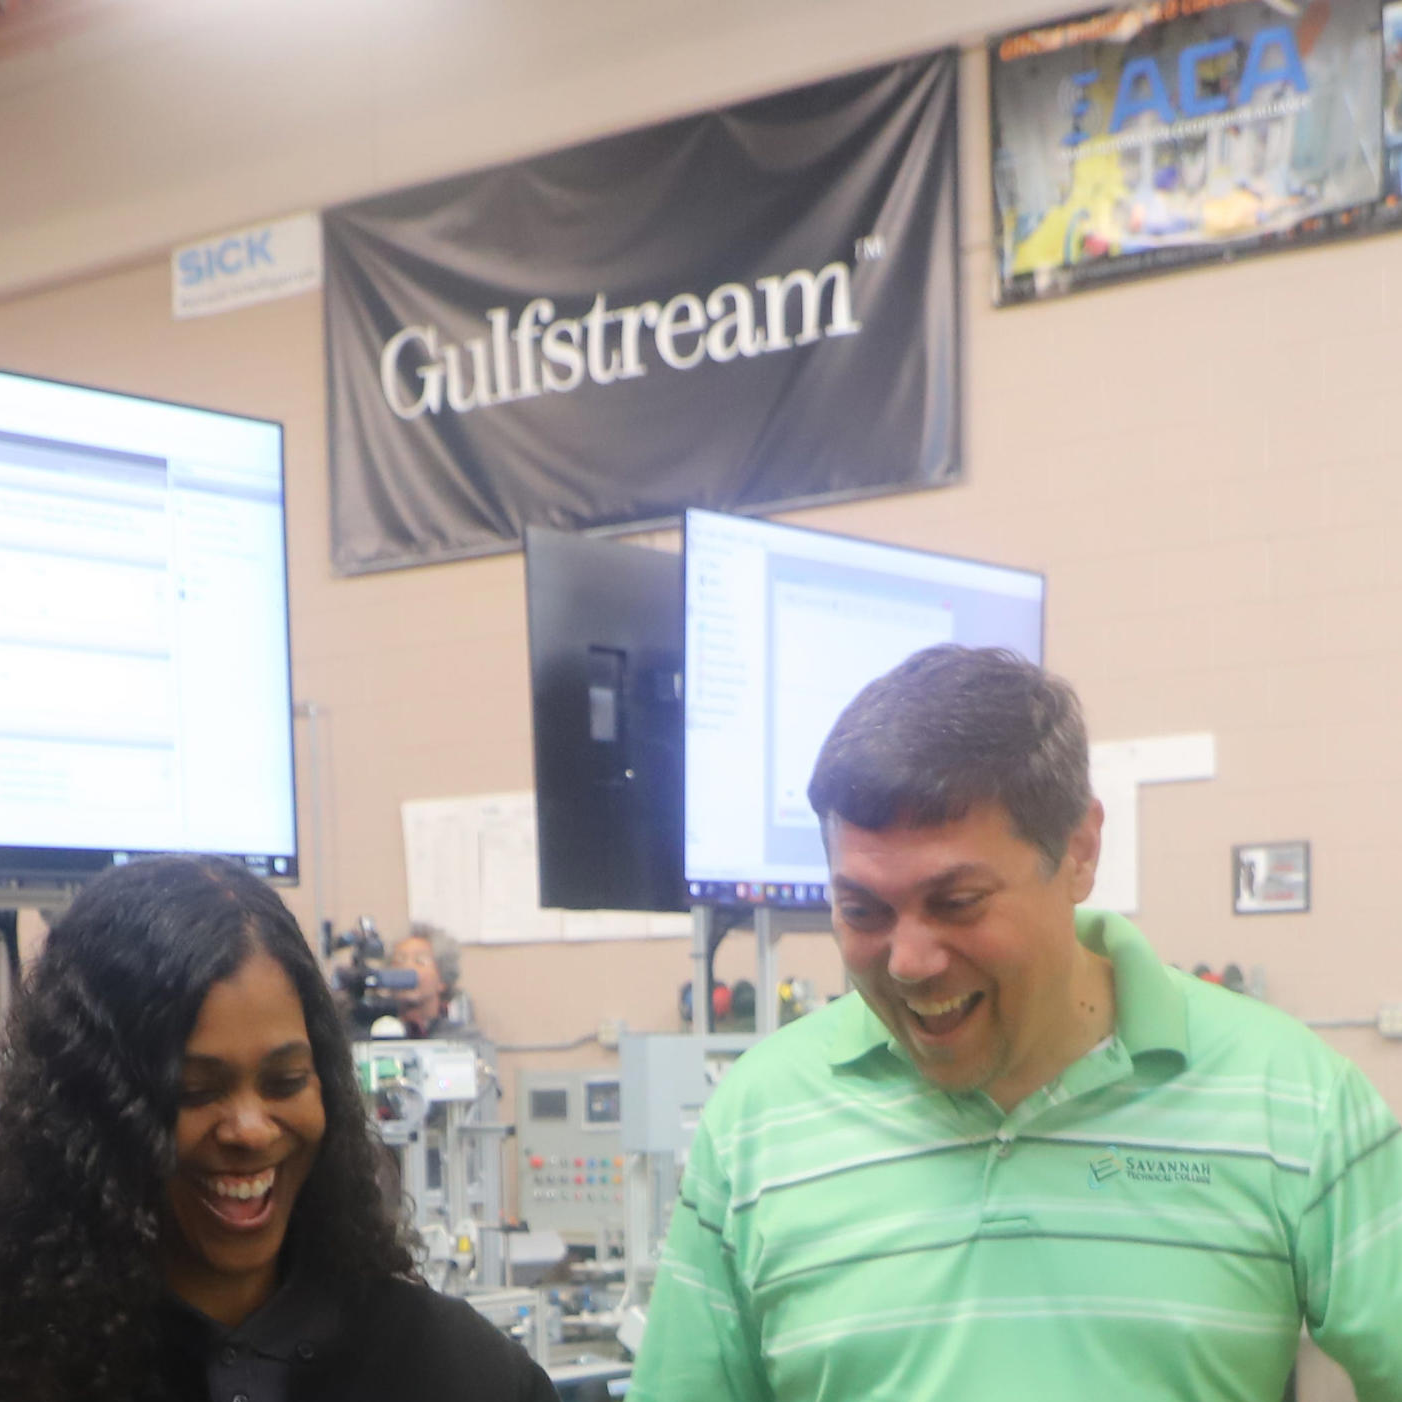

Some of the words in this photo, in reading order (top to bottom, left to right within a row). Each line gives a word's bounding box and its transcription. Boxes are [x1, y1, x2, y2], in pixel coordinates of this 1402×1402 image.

[178, 228, 275, 288] SICK
[380, 261, 862, 421] Gulfstream
[1125, 1157, 1211, 1176] SAVANNAH
